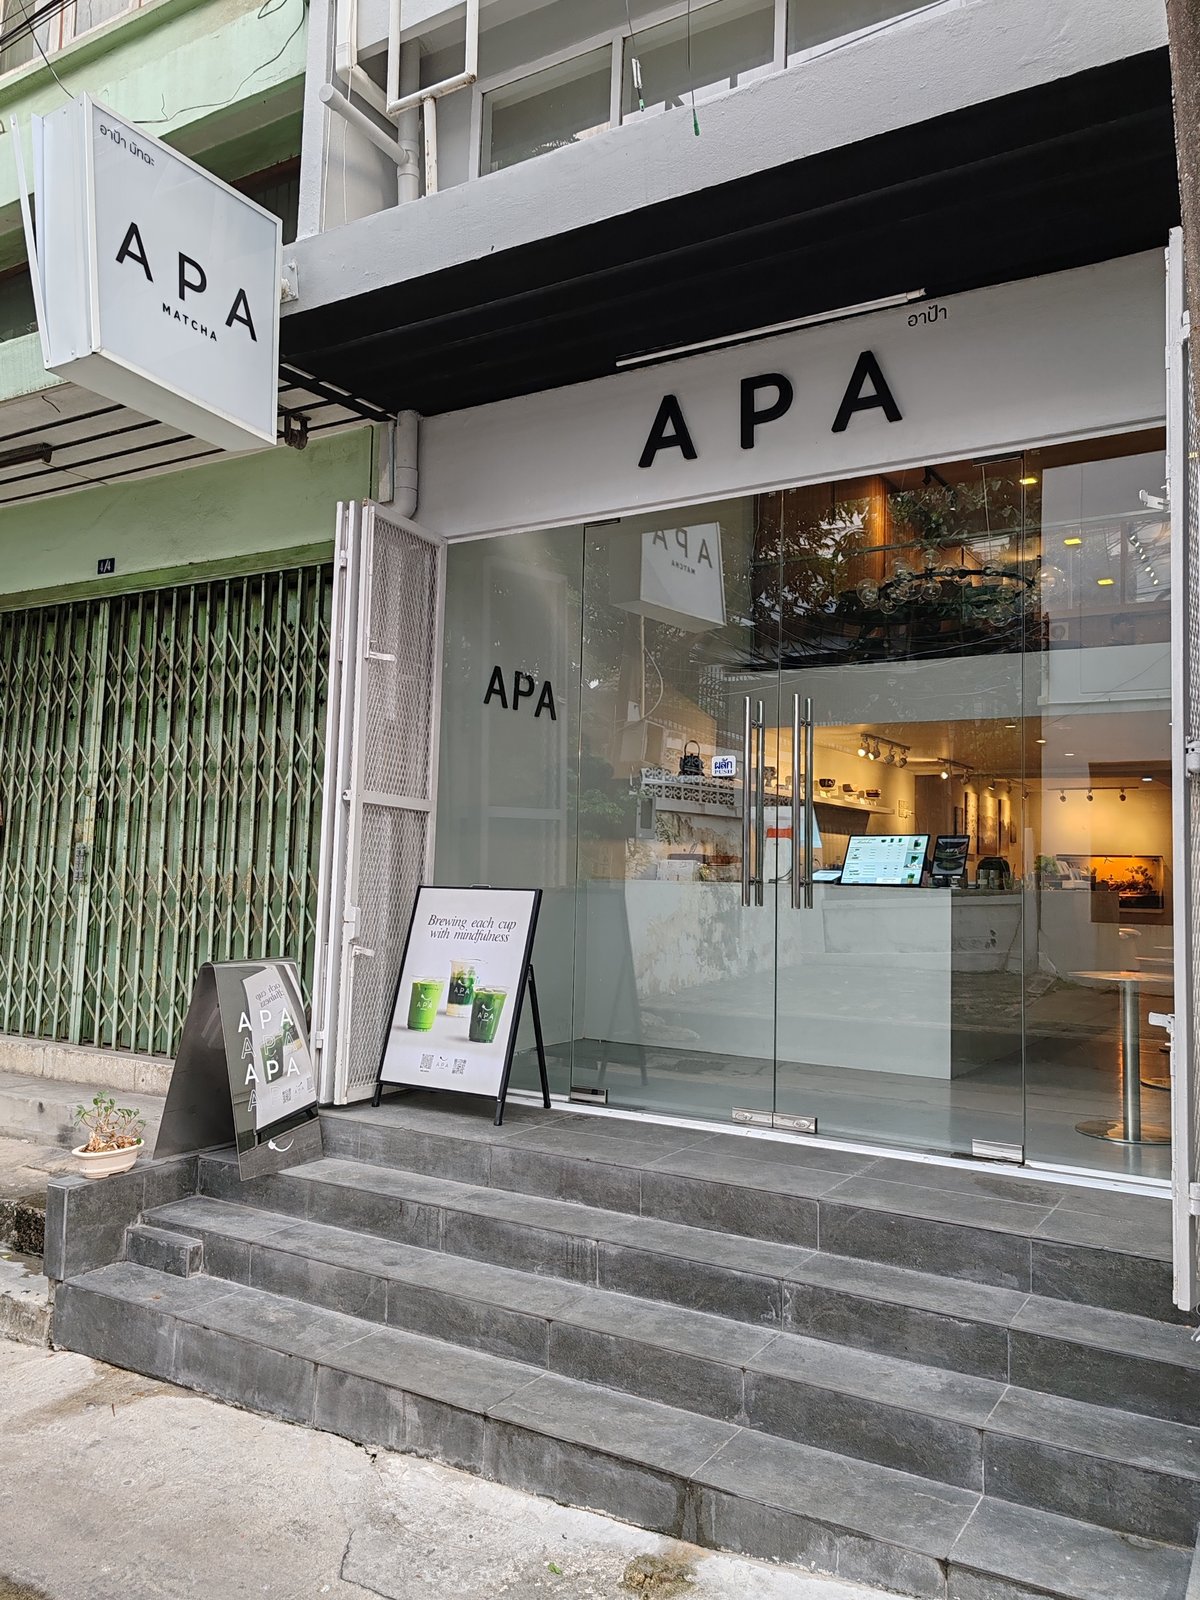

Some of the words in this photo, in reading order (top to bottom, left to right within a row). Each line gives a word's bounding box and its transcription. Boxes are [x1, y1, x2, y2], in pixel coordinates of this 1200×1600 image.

[99, 124, 127, 149] อาป้า
[115, 221, 258, 342] APA
[162, 302, 218, 342] MATCHA
[907, 304, 948, 327] อาป้า
[638, 350, 903, 468] APA
[483, 665, 557, 721] APA
[714, 757, 733, 770] ผลัก
[427, 914, 468, 931] Brewing
[471, 916, 495, 929] each
[498, 920, 517, 933] cup
[430, 927, 450, 940] with
[453, 929, 510, 944] mindfulness
[416, 1001, 433, 1009] APA
[477, 1012, 494, 1020] APA
[238, 1008, 294, 1033] APA
[245, 1057, 301, 1086] APA
